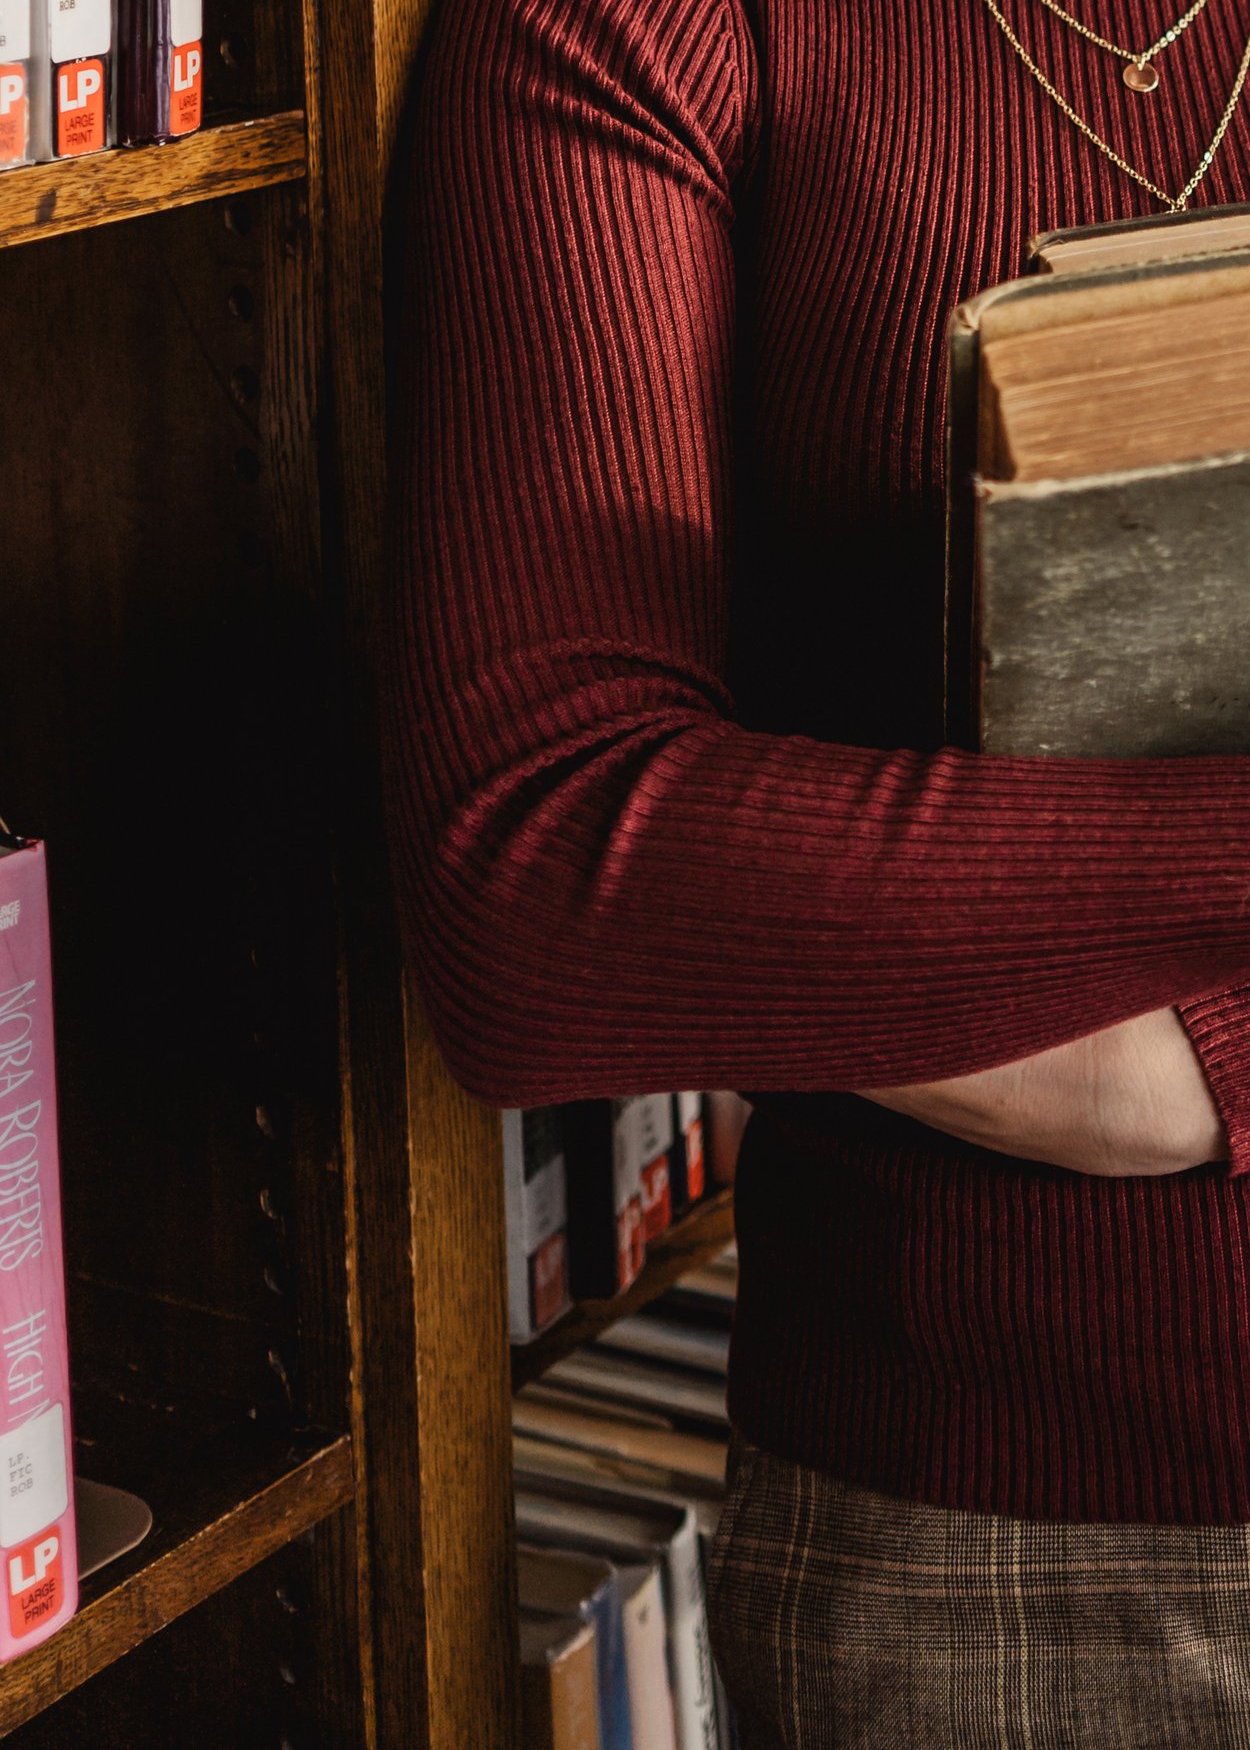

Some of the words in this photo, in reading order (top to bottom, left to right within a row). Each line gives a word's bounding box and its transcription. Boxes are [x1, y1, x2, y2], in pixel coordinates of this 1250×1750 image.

[59, 0, 76, 12] ROB
[173, 50, 201, 92] LP
[59, 68, 101, 114] LP
[178, 92, 199, 112] LARGE
[64, 112, 95, 132] LARGE
[179, 110, 197, 128] PRINT
[66, 129, 93, 148] PRINT
[0, 1099, 44, 1271] ROBERTS
[2, 1307, 47, 1405] HIGH
[9, 1463, 33, 1482] FIC
[10, 1478, 34, 1498] ROB
[9, 1536, 59, 1596] LP
[21, 1578, 56, 1611] LARGE
[24, 1595, 54, 1624] PRINT
